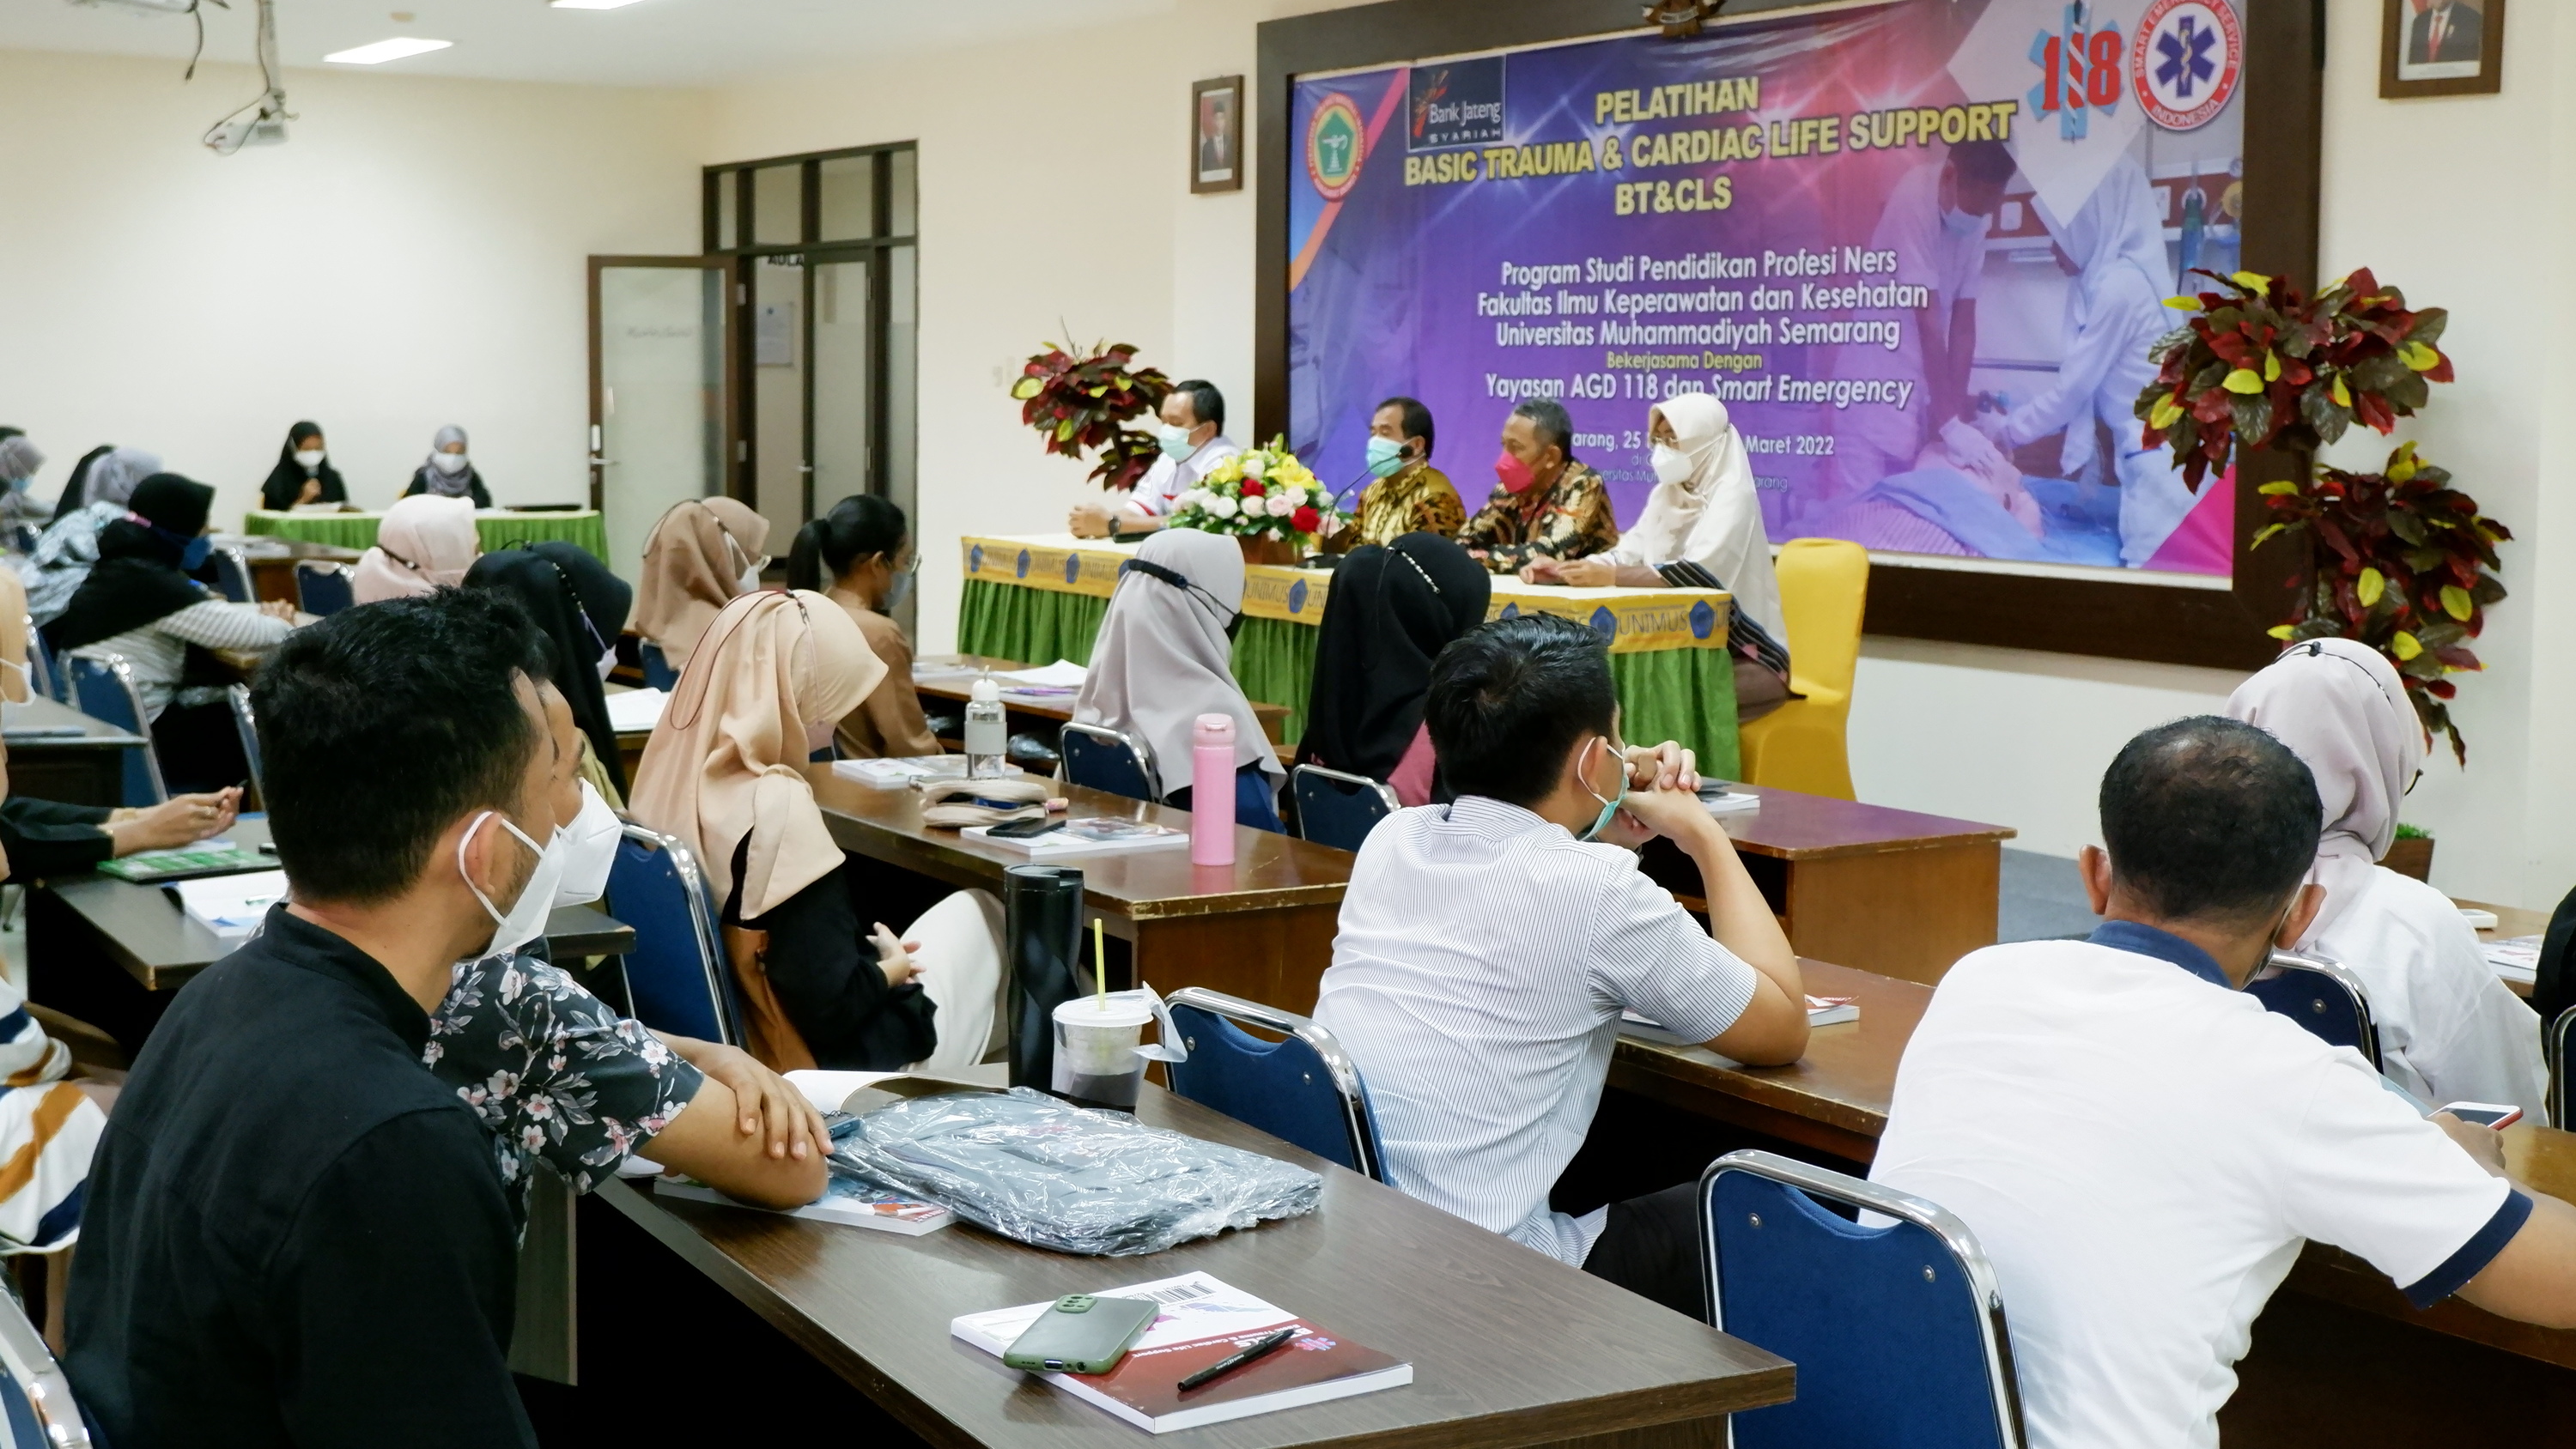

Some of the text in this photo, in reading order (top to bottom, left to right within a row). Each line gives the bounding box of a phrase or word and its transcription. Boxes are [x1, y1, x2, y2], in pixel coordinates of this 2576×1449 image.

[1429, 100, 1501, 126] Bank Jateng
[1595, 76, 1759, 124] PELATIHAN
[2151, 99, 2220, 127] INDONESIA
[1405, 100, 2019, 186] BASIC TRAUMA & CARDIAC LIFE SUPPORT
[1427, 128, 1502, 144] SYARIAH
[1615, 179, 1733, 215] BT&CLS
[1500, 246, 1898, 290] Program Studi Pendidikan Profesi Ners
[1477, 282, 1929, 320] Fakultas Ilmu Keperawatan dan Kesehatan
[1496, 316, 1901, 351] Universitas Muhammadiyah Semarang
[1607, 349, 1763, 373] Bekerjasama Dengan
[1485, 373, 1914, 410] Yayasan AGD 118 dan Smart Emergency
[1572, 432, 1619, 453] arang,
[1622, 430, 1642, 450] 25
[1745, 434, 1835, 456] Maret 2022
[1631, 452, 1642, 466] di
[1755, 476, 1789, 493] arang
[1617, 610, 1688, 637] UNIMUS
